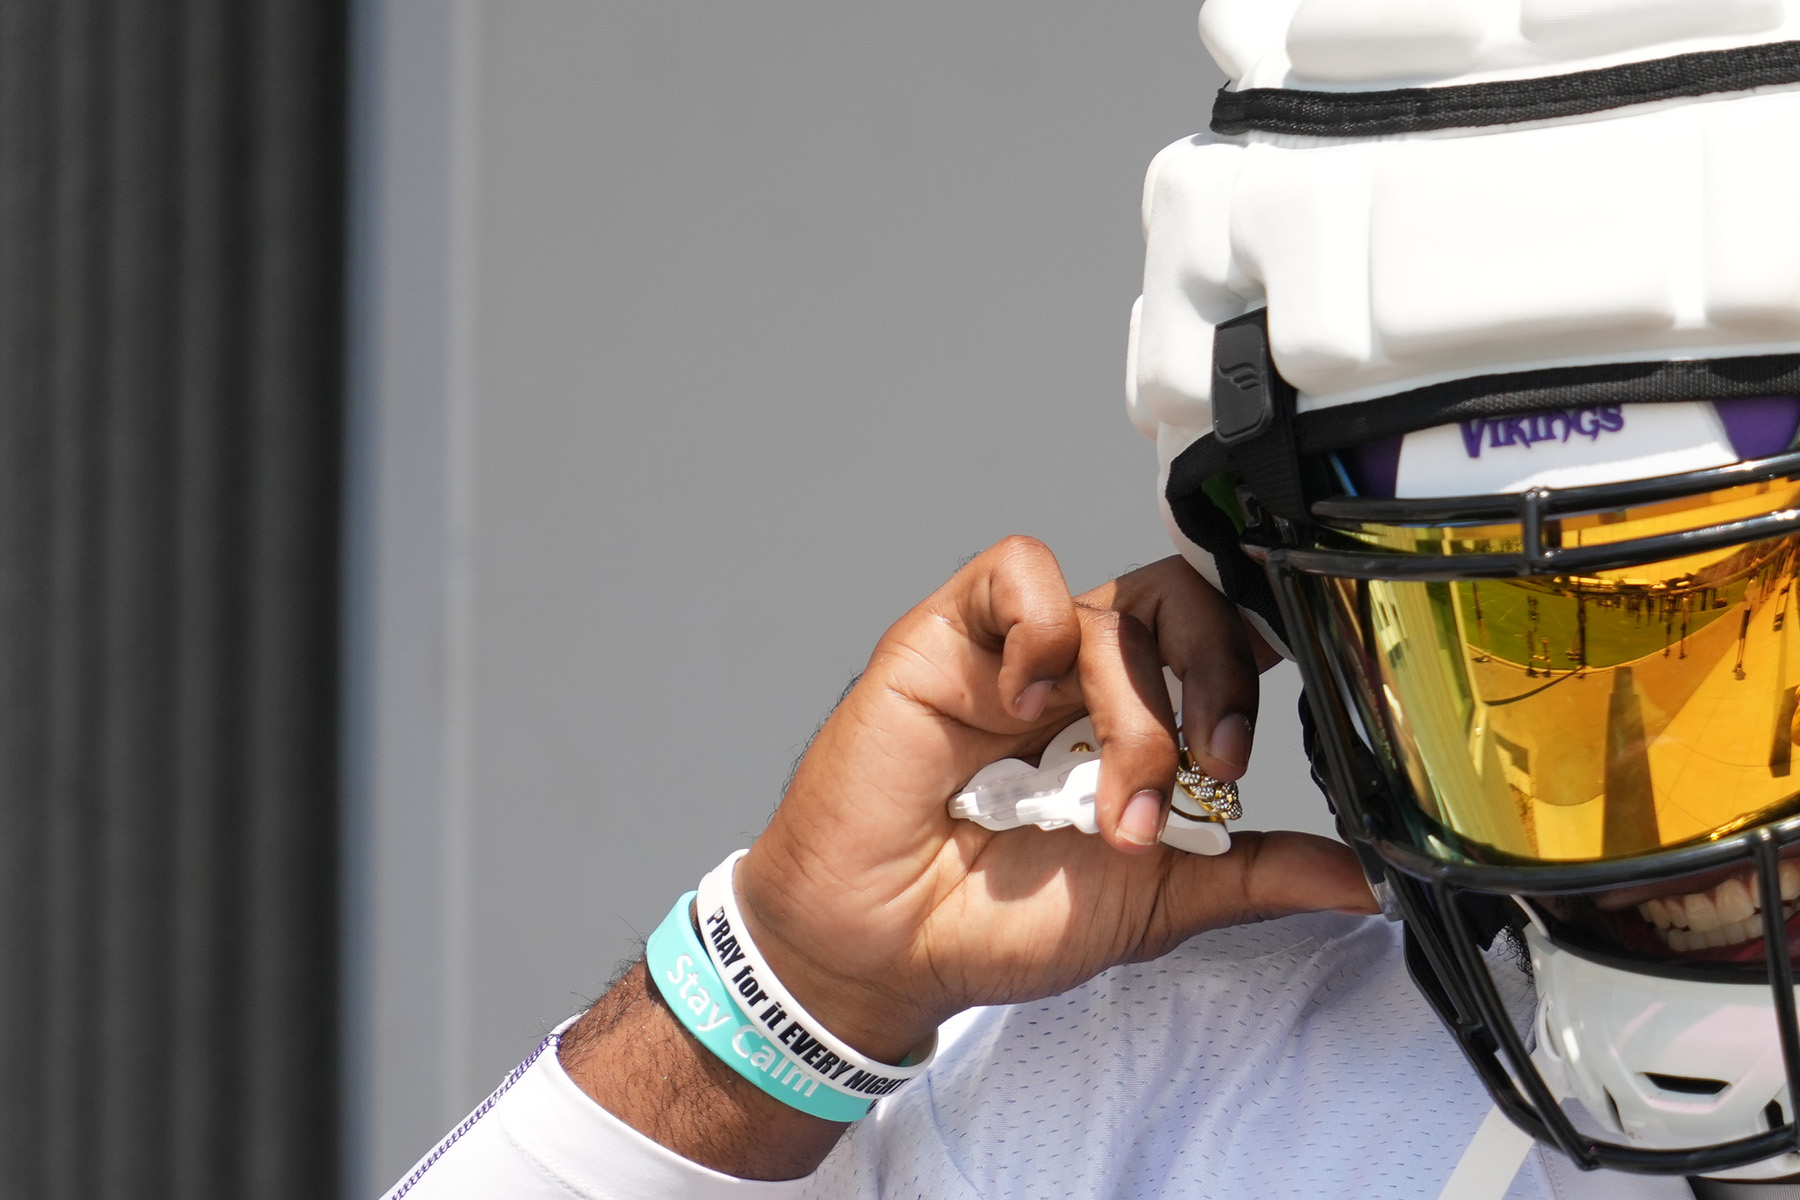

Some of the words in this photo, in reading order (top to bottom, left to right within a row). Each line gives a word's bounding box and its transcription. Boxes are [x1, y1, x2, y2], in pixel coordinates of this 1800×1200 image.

[667, 953, 732, 1032] Stay
[731, 1024, 822, 1097] Calm
[706, 905, 746, 968] PRAY
[732, 965, 770, 1008] for
[759, 1001, 789, 1031] it
[778, 1022, 853, 1087] EVERY
[843, 1069, 912, 1095] NIGHT
